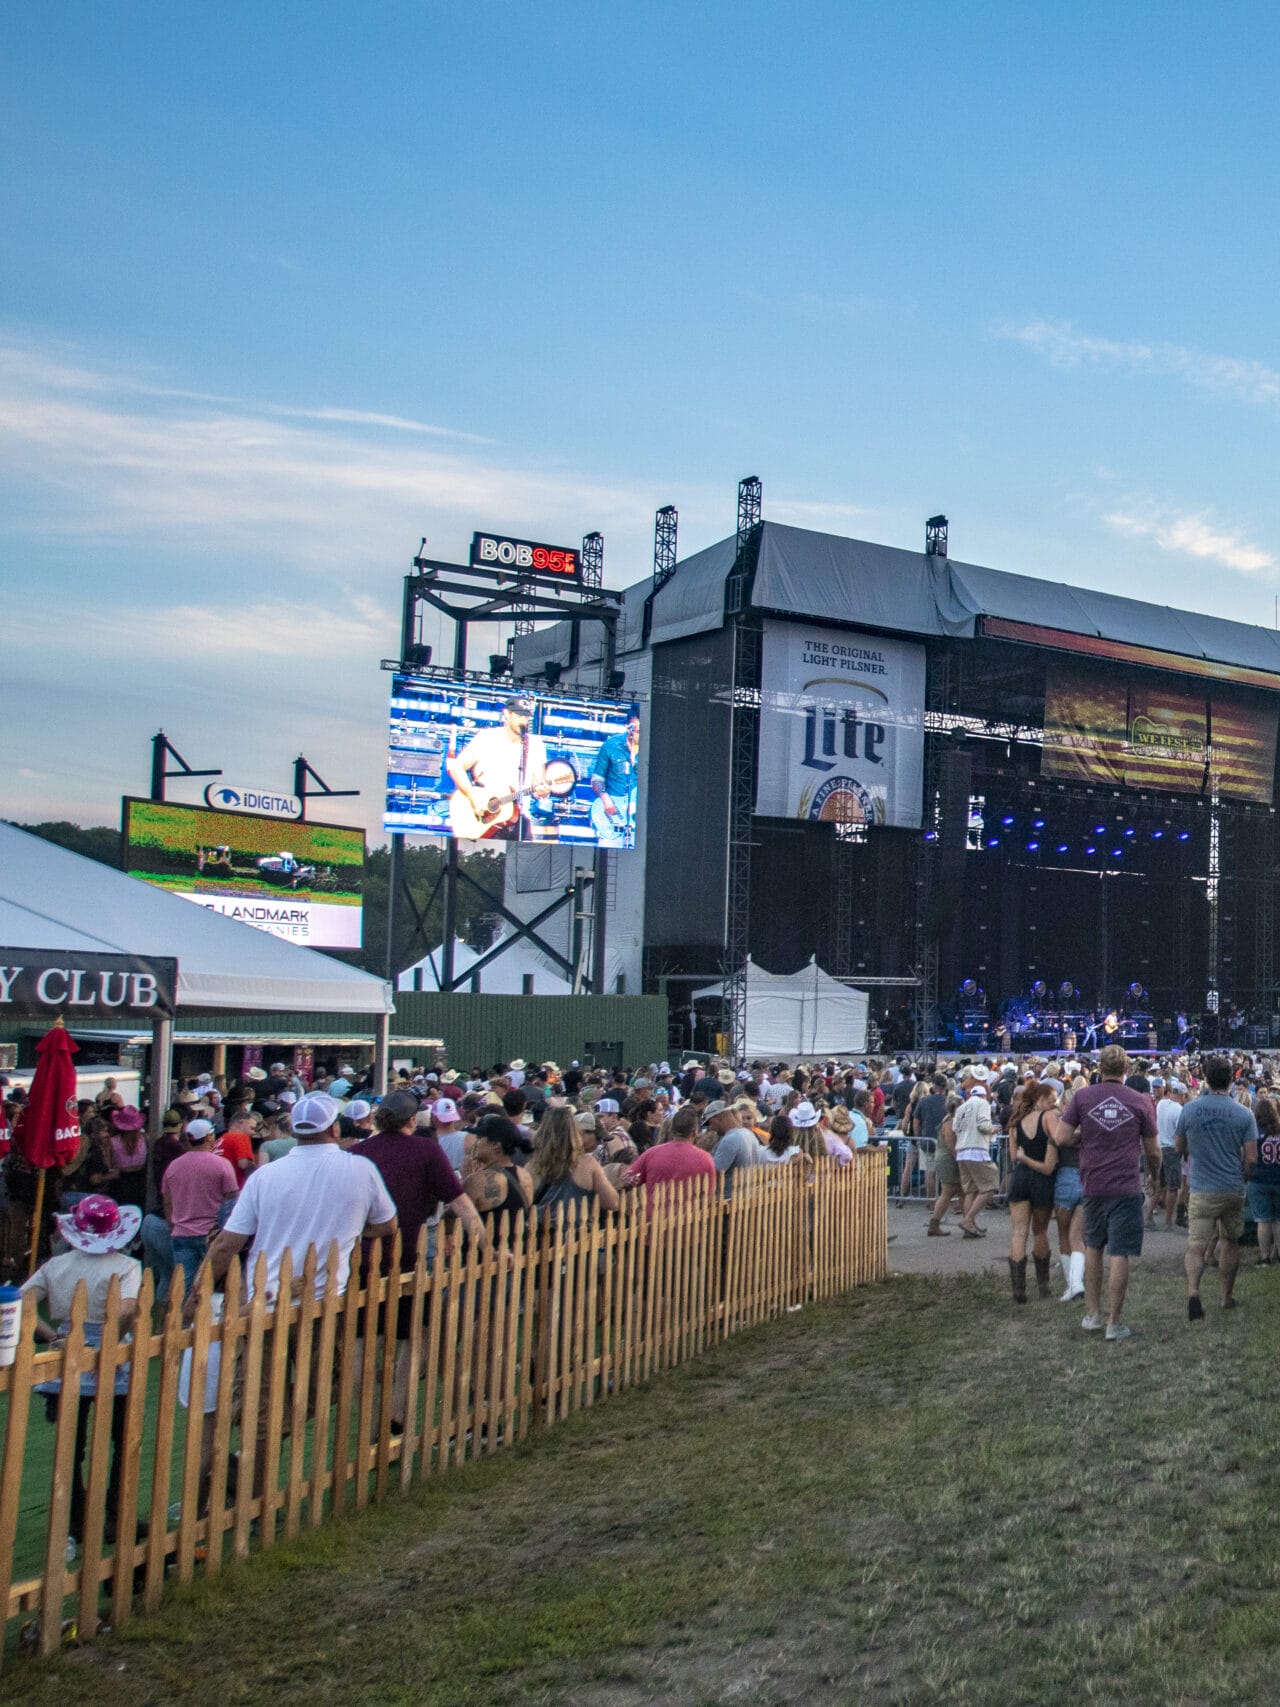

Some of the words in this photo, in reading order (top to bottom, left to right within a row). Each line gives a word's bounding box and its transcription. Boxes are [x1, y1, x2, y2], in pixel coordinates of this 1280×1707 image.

[803, 653, 838, 669] LIGHT
[804, 640, 829, 654] THE
[831, 644, 885, 662] ORIGINAL
[801, 705, 886, 771] Lite
[243, 791, 298, 814] iDIGITAL
[816, 780, 838, 804] FINE
[36, 967, 158, 1007] CLUB
